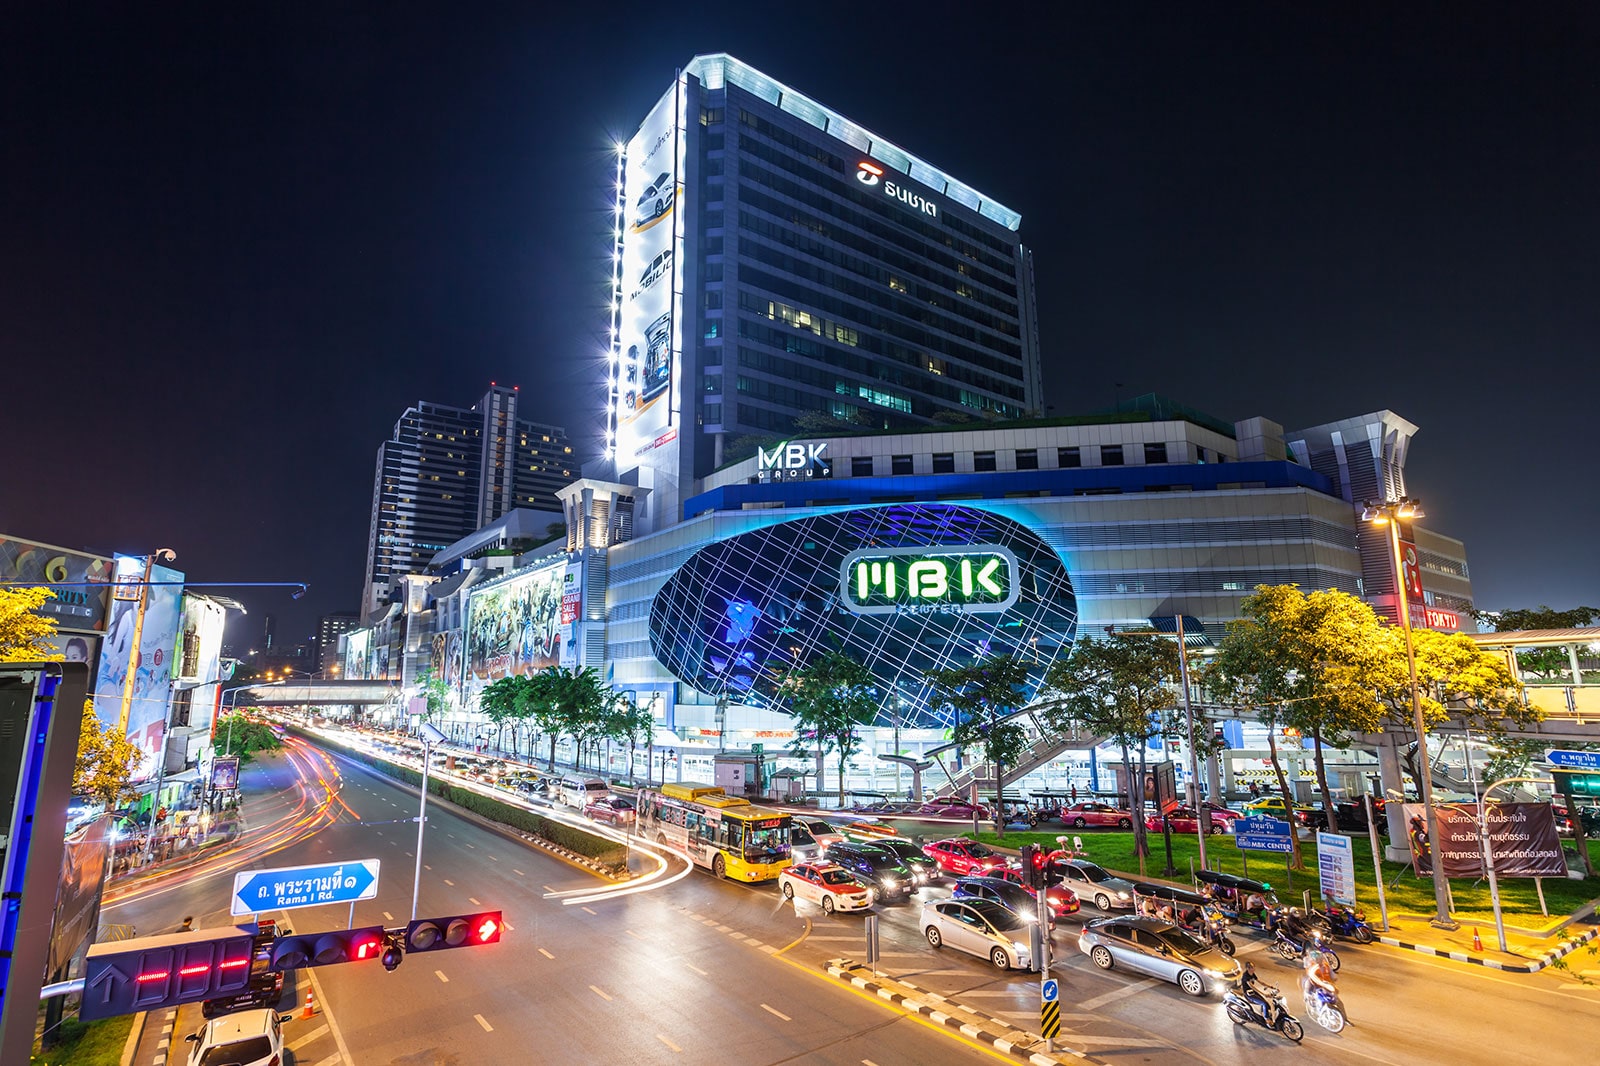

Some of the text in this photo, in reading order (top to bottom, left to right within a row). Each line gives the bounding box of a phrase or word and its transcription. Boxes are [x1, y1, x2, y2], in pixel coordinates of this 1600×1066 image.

[885, 180, 937, 217] ธนชาต
[758, 440, 829, 470] MBK
[757, 468, 830, 480] GROUP
[857, 558, 1002, 600] MBK
[563, 603, 576, 613] SALE
[896, 603, 962, 616] CENTER
[1427, 612, 1457, 628] TOKYU
[1251, 841, 1291, 850] MBK CENTER
[257, 885, 270, 898] ถ.
[274, 866, 343, 897] พระรามที่
[277, 891, 335, 906] Rama I Rd.
